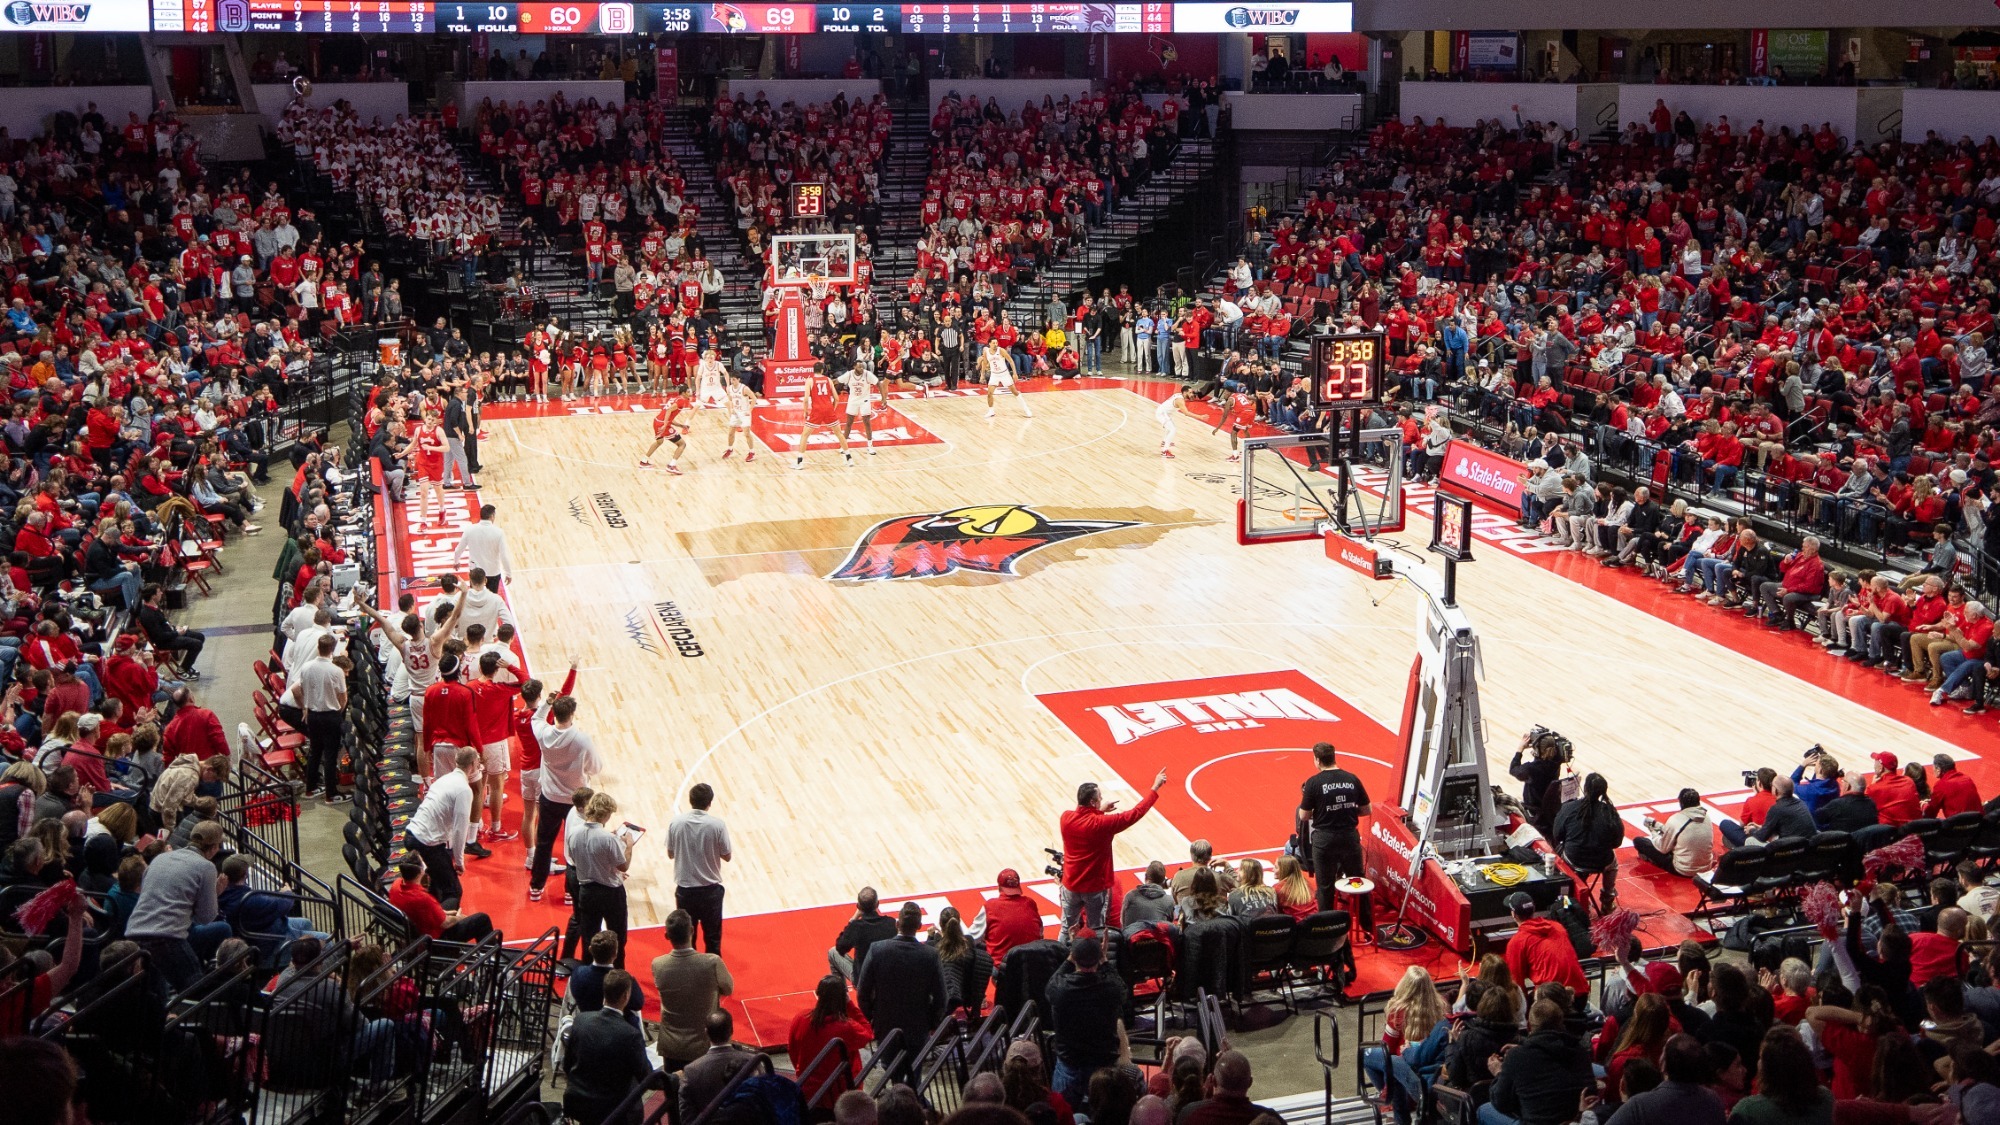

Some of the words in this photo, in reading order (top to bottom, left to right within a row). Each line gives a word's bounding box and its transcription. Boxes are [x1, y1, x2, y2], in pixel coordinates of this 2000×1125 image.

[294, 2, 301, 11] 0
[324, 2, 331, 11] 5
[349, 2, 361, 11] 14
[378, 3, 390, 11] 21
[409, 3, 425, 12] 35
[456, 6, 464, 20] 1
[488, 6, 507, 20] 10
[913, 5, 921, 13] 0
[942, 5, 950, 13] 3
[972, 5, 980, 13] 5
[1001, 5, 1011, 13] 11
[1030, 5, 1045, 13] 35
[1147, 4, 1162, 12] 87
[31, 4, 87, 24] WJBC
[192, 10, 208, 20] 44
[294, 12, 301, 21] 7
[324, 12, 331, 21] 2
[352, 12, 360, 21] 4
[378, 13, 390, 22] 16
[410, 13, 424, 22] 13
[550, 7, 581, 25] 60
[662, 9, 691, 21] 3:58
[766, 8, 795, 25] 69
[832, 8, 850, 21] 10
[873, 8, 884, 21] 2
[910, 15, 924, 23] 25
[943, 15, 950, 23] 9
[972, 14, 980, 22] 4
[1002, 14, 1011, 22] 11
[1031, 14, 1043, 22] 13
[1147, 13, 1162, 22] 44
[1247, 10, 1295, 25] WJBC
[193, 22, 208, 32] 42
[295, 22, 302, 31] 3
[324, 22, 332, 31] 2
[352, 22, 360, 32] 2
[382, 23, 388, 32] 1
[414, 23, 422, 32] 3
[447, 24, 471, 32] TOL
[477, 24, 517, 32] FOULS
[665, 22, 689, 31] 2ND
[913, 24, 921, 32] 3
[943, 24, 950, 32] 2
[973, 24, 979, 32] 1
[1003, 24, 1009, 32] 1
[1035, 24, 1040, 32] 1
[1147, 23, 1162, 32] 33
[801, 186, 822, 196] 3:58
[798, 196, 820, 214] 23
[1335, 341, 1374, 362] 3:58
[1326, 363, 1367, 399] 23
[816, 383, 828, 395] 14
[654, 600, 687, 628] ARENA
[667, 627, 705, 658] CEFCU
[409, 653, 430, 671] 33
[461, 664, 470, 681] 4
[1091, 687, 1343, 745] VALLEY
[1191, 722, 1266, 734] THE
[1335, 795, 1347, 803] ISU
[1381, 828, 1414, 863] StateFar
